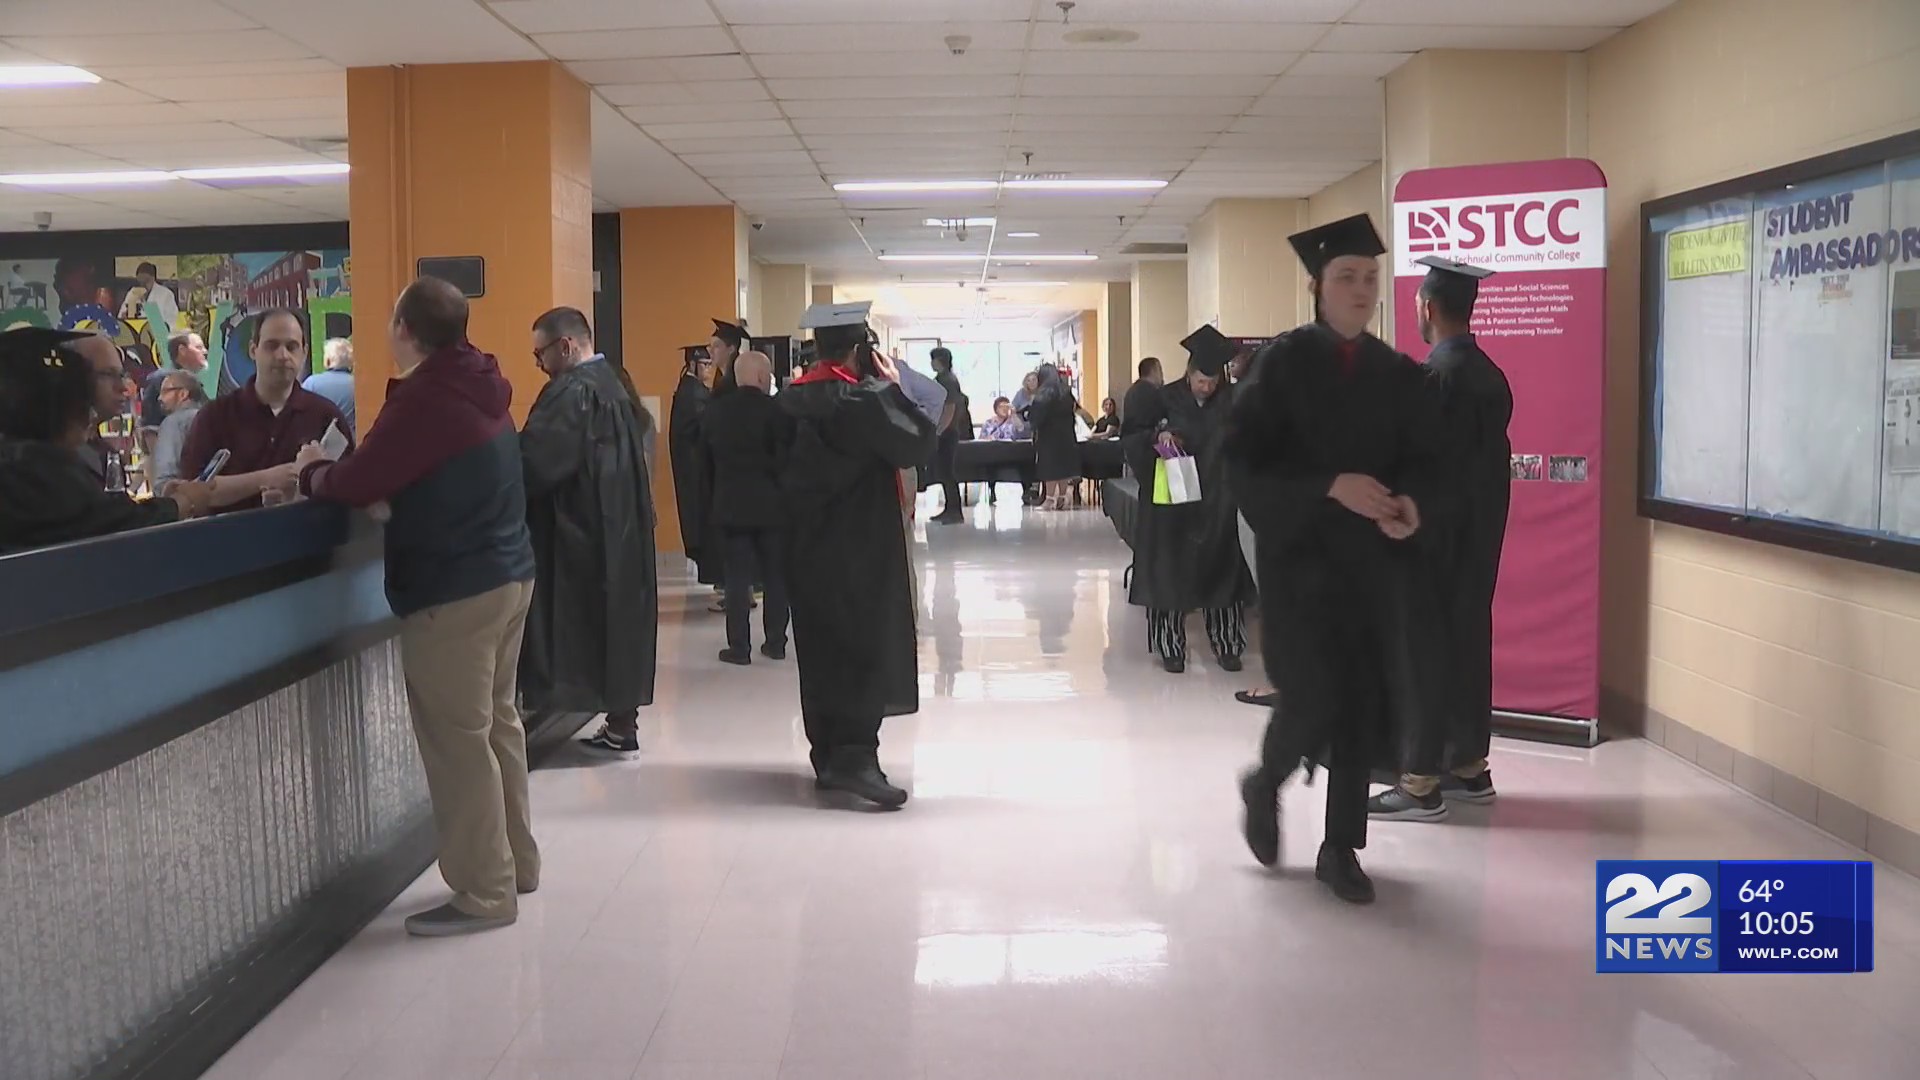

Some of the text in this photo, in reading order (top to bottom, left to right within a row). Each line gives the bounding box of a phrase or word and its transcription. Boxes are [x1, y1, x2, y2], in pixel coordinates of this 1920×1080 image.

[1767, 193, 1854, 237] STUDENT
[1458, 199, 1580, 249] STCC
[1455, 253, 1492, 265] Technical
[1495, 251, 1545, 264] Community
[1547, 249, 1581, 262] College
[1504, 284, 1517, 292] and
[1519, 283, 1539, 292] Social
[1540, 283, 1569, 291] Sciences
[1489, 295, 1528, 304] Information
[1529, 294, 1574, 303] Technologies
[1491, 306, 1535, 315] Technologies
[1536, 305, 1549, 313] and
[1550, 304, 1568, 312] Math
[1493, 317, 1517, 325] Patient
[1518, 316, 1554, 325] Simulation
[1482, 328, 1493, 336] and
[1495, 328, 1535, 337] Engineering
[1536, 327, 1564, 336] Transfer
